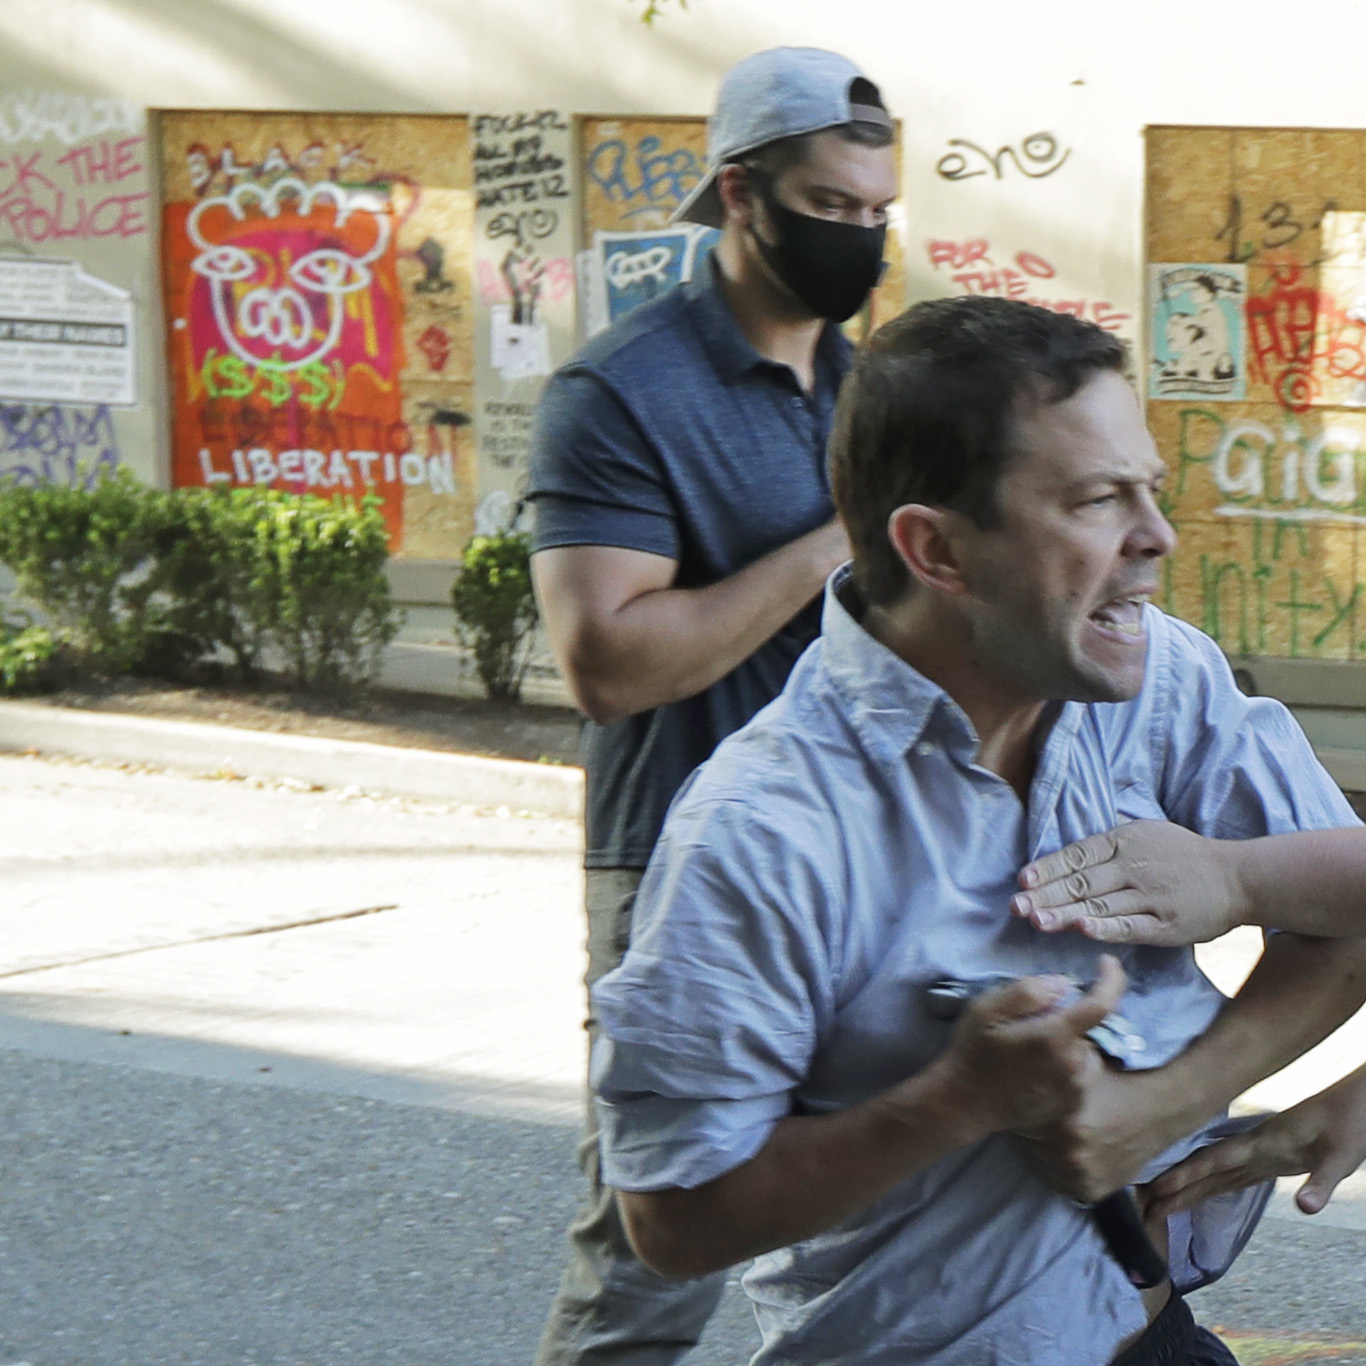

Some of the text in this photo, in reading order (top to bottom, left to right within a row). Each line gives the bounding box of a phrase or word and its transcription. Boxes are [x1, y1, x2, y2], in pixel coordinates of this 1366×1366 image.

[56, 136, 147, 186] THE
[0, 187, 150, 242] POLICE
[926, 238, 994, 270] FOR
[953, 269, 1030, 297] THE
[199, 447, 456, 496] LIBERATION
